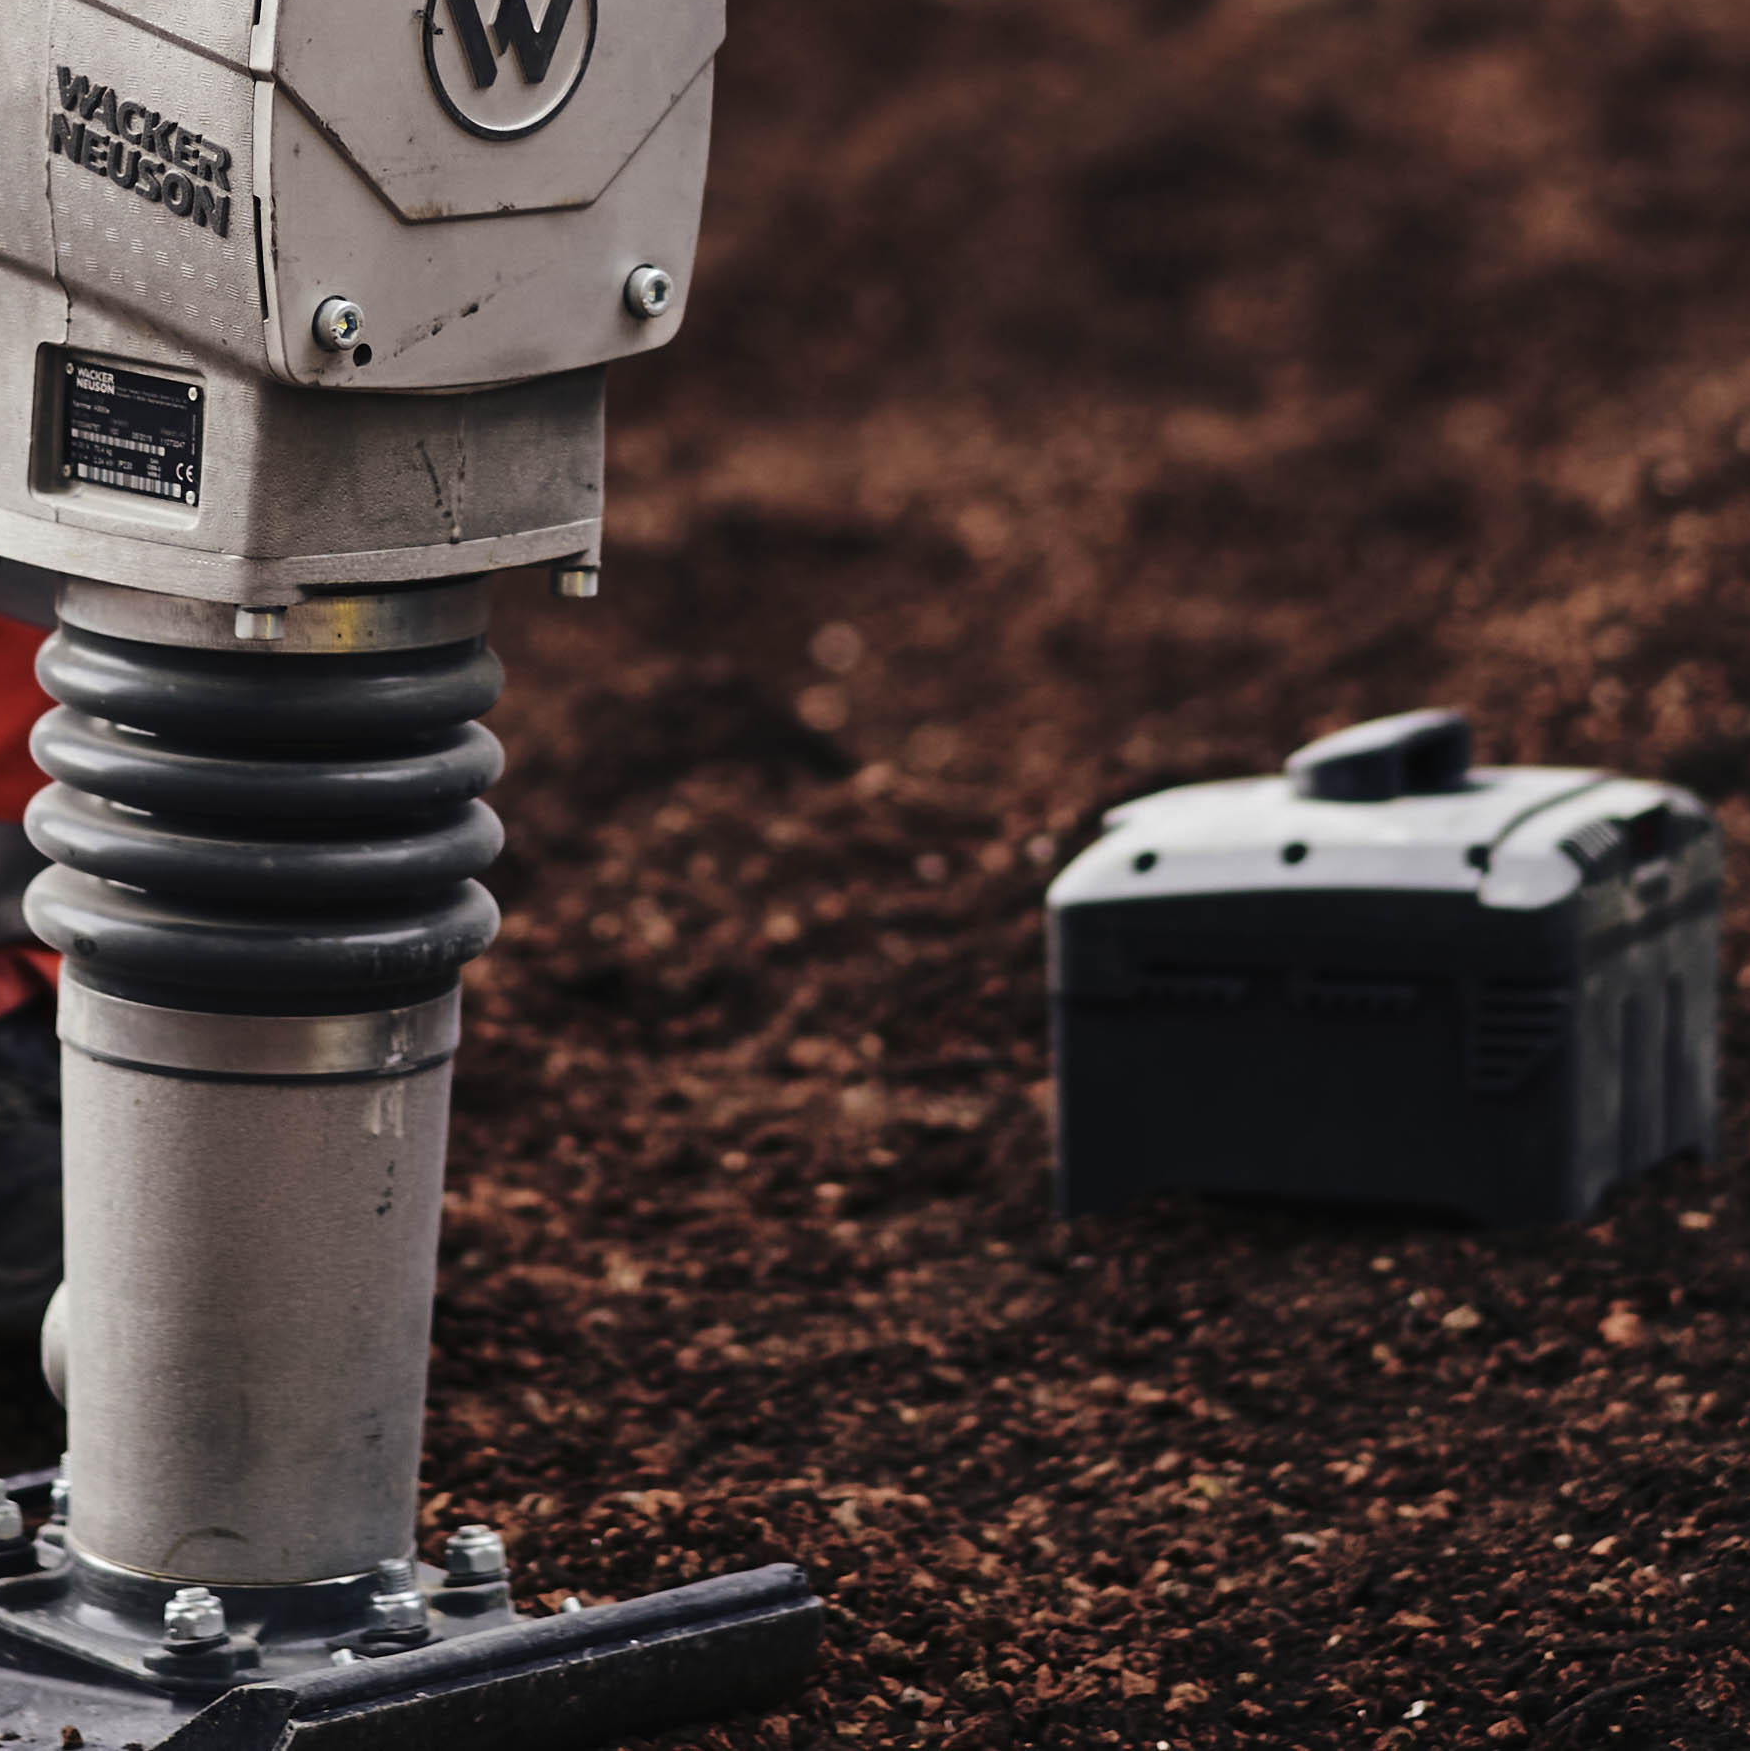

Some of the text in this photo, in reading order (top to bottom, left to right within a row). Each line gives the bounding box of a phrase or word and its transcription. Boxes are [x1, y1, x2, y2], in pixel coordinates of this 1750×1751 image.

[56, 65, 231, 192] WACKER
[50, 112, 231, 239] NEUSON
[76, 378, 116, 395] NEUSON
[77, 367, 114, 384] WACKER
